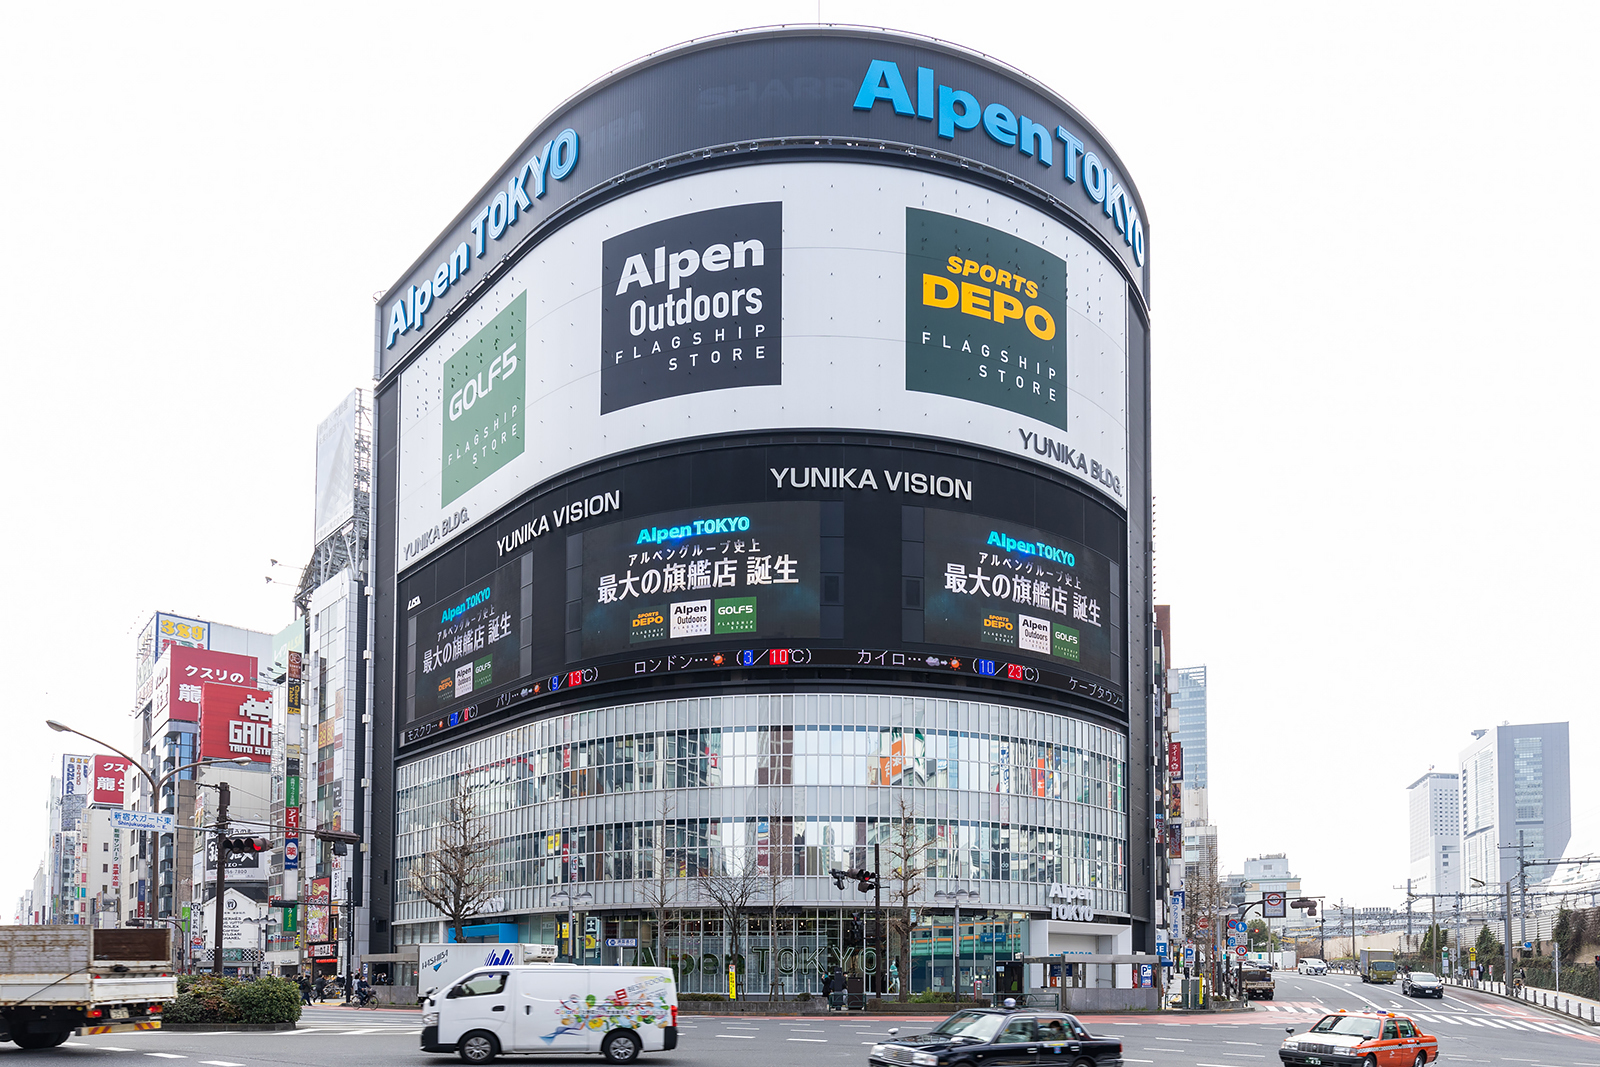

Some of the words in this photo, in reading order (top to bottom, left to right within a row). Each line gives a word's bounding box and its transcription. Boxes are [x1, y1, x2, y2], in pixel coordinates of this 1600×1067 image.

[853, 58, 1053, 168] Alpen
[1056, 125, 1146, 267] TOKYO
[386, 240, 470, 349] Alpen
[470, 127, 579, 259] TOKYO
[616, 239, 764, 296] Alpen
[946, 255, 1039, 299] SPORTS
[630, 287, 763, 336] Outdoors
[922, 273, 1056, 341] DEPO
[615, 324, 765, 364] FLAGSHIP
[668, 346, 765, 371] STORE
[922, 332, 1056, 380] FLAGSHIP
[449, 342, 517, 421] GOLF5
[979, 364, 1056, 402] STORE
[448, 404, 517, 465] FLAGSHIP
[472, 423, 517, 465] STORE
[1018, 428, 1088, 475] YUNIKA
[1090, 459, 1123, 498] BLDG.
[770, 467, 878, 490] YUNIKA
[883, 470, 972, 501] VISION
[403, 525, 441, 561] YUNIKA
[441, 506, 470, 537] BLDG.
[496, 514, 550, 557] YUNIKA
[552, 490, 621, 529] VISION
[636, 523, 692, 544] Alpen
[693, 516, 750, 535] TOKYO
[628, 539, 761, 567] アルペングループ史上
[987, 530, 1035, 555] Alpen
[1036, 541, 1075, 567] TOKYO
[597, 557, 738, 604] 最大の旗艦店
[746, 554, 799, 585] 誕生
[978, 551, 1081, 590] アルペングループ史上
[441, 602, 466, 624] Alpen
[465, 587, 491, 610] TOKYO
[674, 605, 707, 615] Alpen
[718, 605, 753, 615] GOLF5
[944, 562, 1068, 616] 最大の旗艦店
[1072, 591, 1102, 628] 誕生
[632, 616, 664, 628] DEPO
[637, 611, 659, 619] SPORTS
[677, 615, 707, 625] Outdoors
[983, 618, 1014, 631] DEPO
[989, 614, 1009, 622] SPORTS
[1022, 619, 1048, 632] Alpen
[422, 629, 485, 674] 最大の旗艦店
[488, 611, 512, 644] 誕生
[1024, 629, 1048, 642] Outdoors
[1055, 631, 1078, 645] GOLF5
[185, 665, 244, 683] クスリの
[438, 680, 453, 692] DEPO
[457, 667, 471, 678] Alpen
[229, 744, 253, 754] TAITO
[114, 811, 172, 825] 新宿大ガード東
[1049, 882, 1094, 903] Alpen
[1049, 903, 1094, 922] TOKYO
[752, 945, 879, 976] TOKYO
